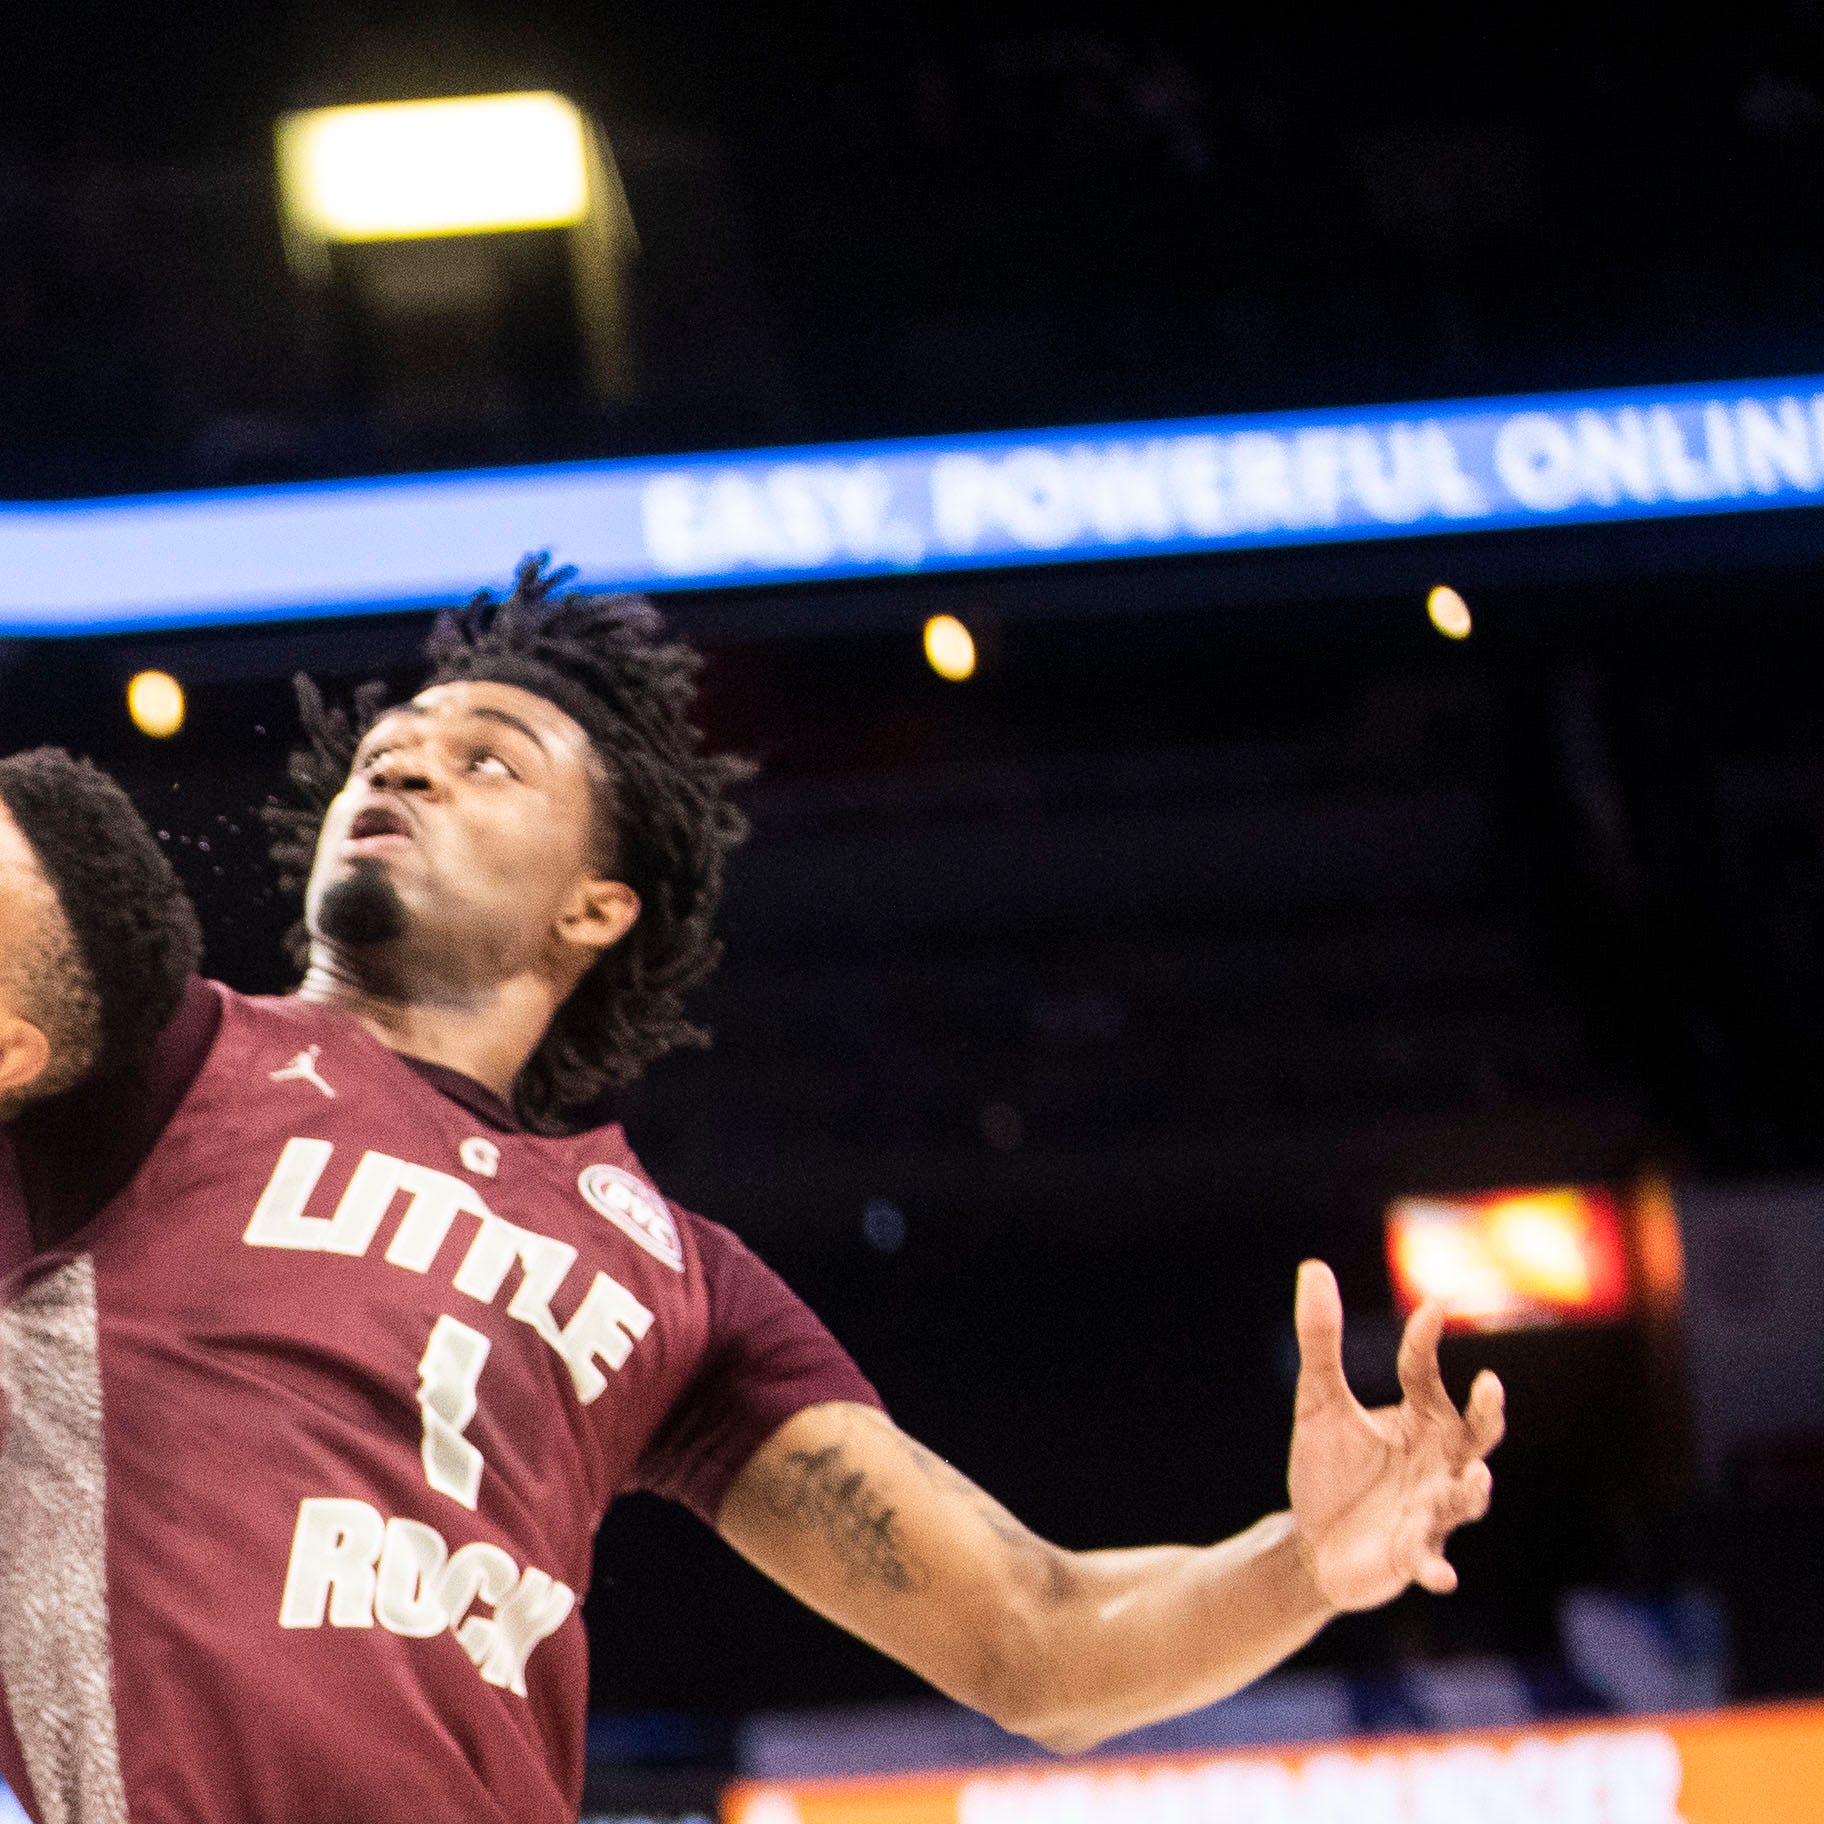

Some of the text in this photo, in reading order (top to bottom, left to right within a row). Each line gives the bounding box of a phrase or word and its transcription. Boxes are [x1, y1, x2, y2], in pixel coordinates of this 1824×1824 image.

[928, 418, 1490, 552] POWERFUL
[1494, 392, 1824, 515] ONLIN
[243, 1136, 655, 1405] LITTLE
[417, 1313, 492, 1512] 1
[279, 1496, 576, 1699] ROCK
